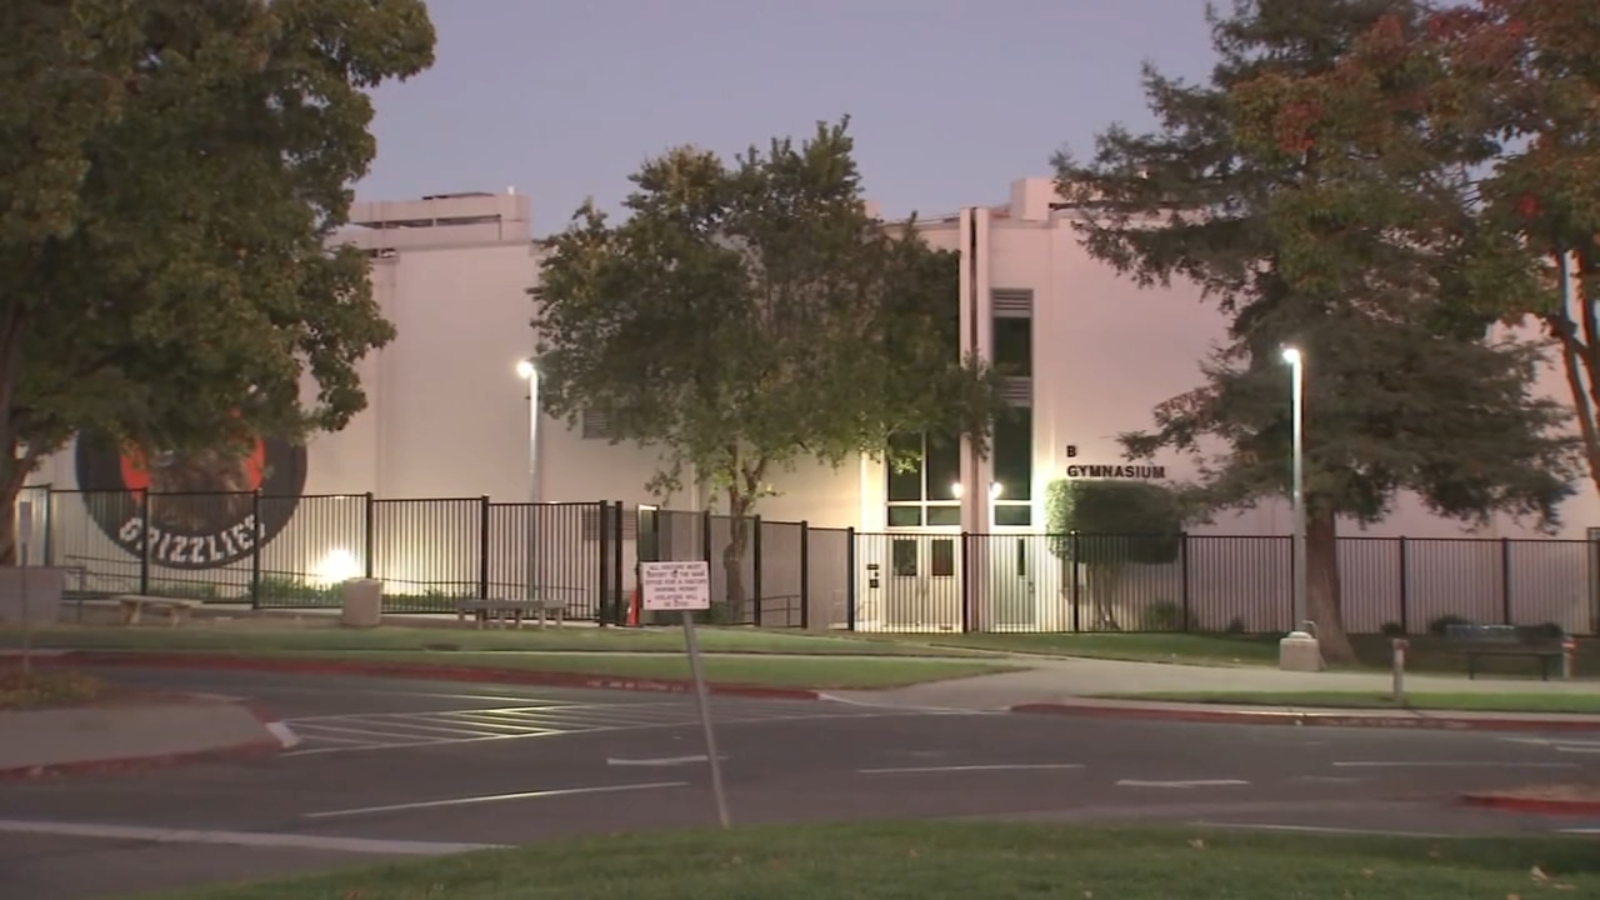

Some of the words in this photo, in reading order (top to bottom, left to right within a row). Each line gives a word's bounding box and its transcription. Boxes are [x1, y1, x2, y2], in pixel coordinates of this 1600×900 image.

[1066, 445, 1077, 458] B
[1067, 465, 1166, 478] GYMNASIUM
[119, 514, 265, 563] GRIZZLIES
